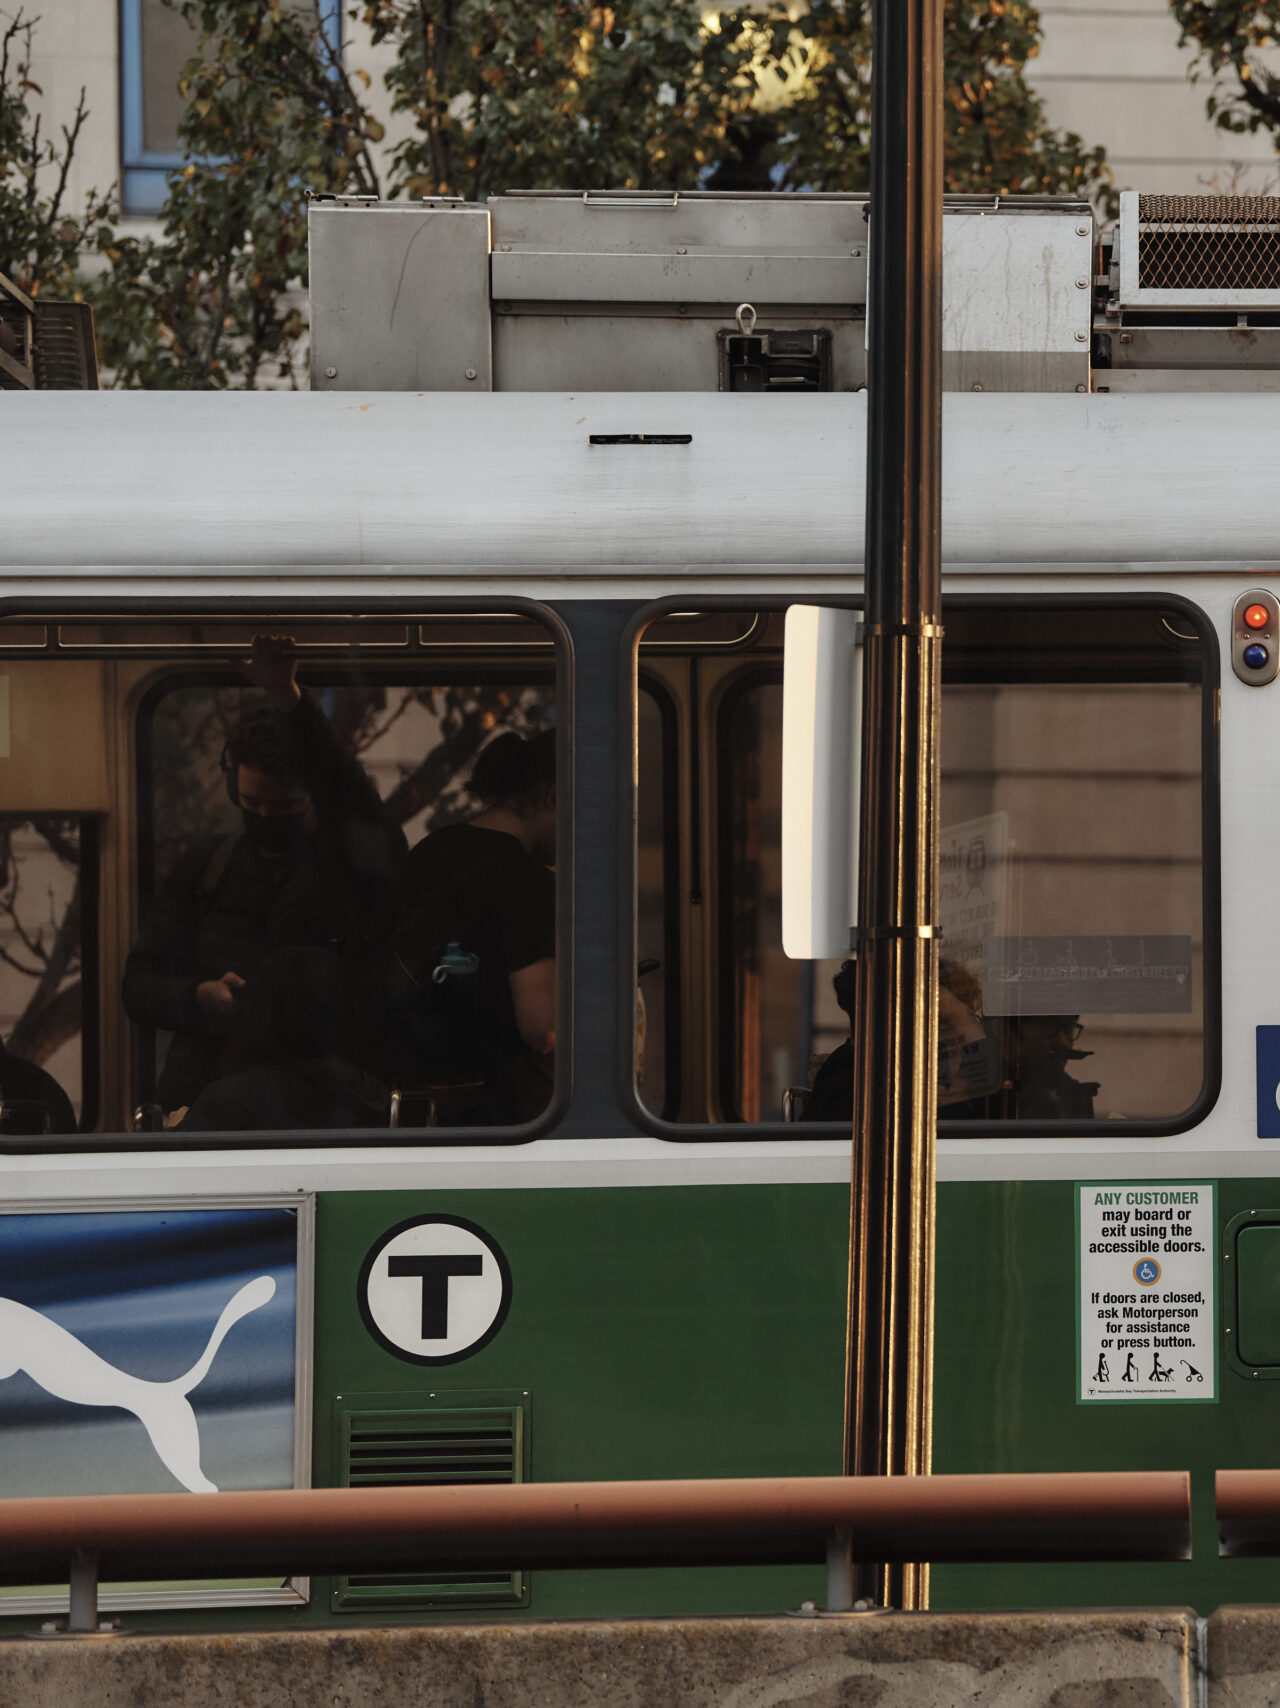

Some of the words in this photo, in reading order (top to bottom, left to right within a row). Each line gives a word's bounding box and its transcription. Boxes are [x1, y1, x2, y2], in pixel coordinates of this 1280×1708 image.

[1094, 1192, 1122, 1205] ANY
[1126, 1192, 1199, 1205] CUSTOMER
[1102, 1210, 1130, 1223] may
[1135, 1208, 1173, 1221] board
[1177, 1210, 1191, 1220] or
[1101, 1224, 1126, 1237] exit
[1130, 1224, 1167, 1239] using
[1171, 1224, 1192, 1237] the
[1089, 1240, 1159, 1253] accessible
[1163, 1240, 1205, 1252] doors.
[388, 1254, 483, 1340] T
[1091, 1292, 1099, 1304] If
[1103, 1292, 1137, 1304] doors
[1140, 1294, 1159, 1304] are
[1163, 1292, 1205, 1305] closed,
[1097, 1307, 1119, 1318] ask
[1122, 1307, 1198, 1320] Motorperson
[1106, 1322, 1123, 1333] for
[1126, 1321, 1190, 1333] assistance
[1101, 1338, 1114, 1348] or
[1117, 1338, 1150, 1350] press
[1153, 1336, 1196, 1348] button.
